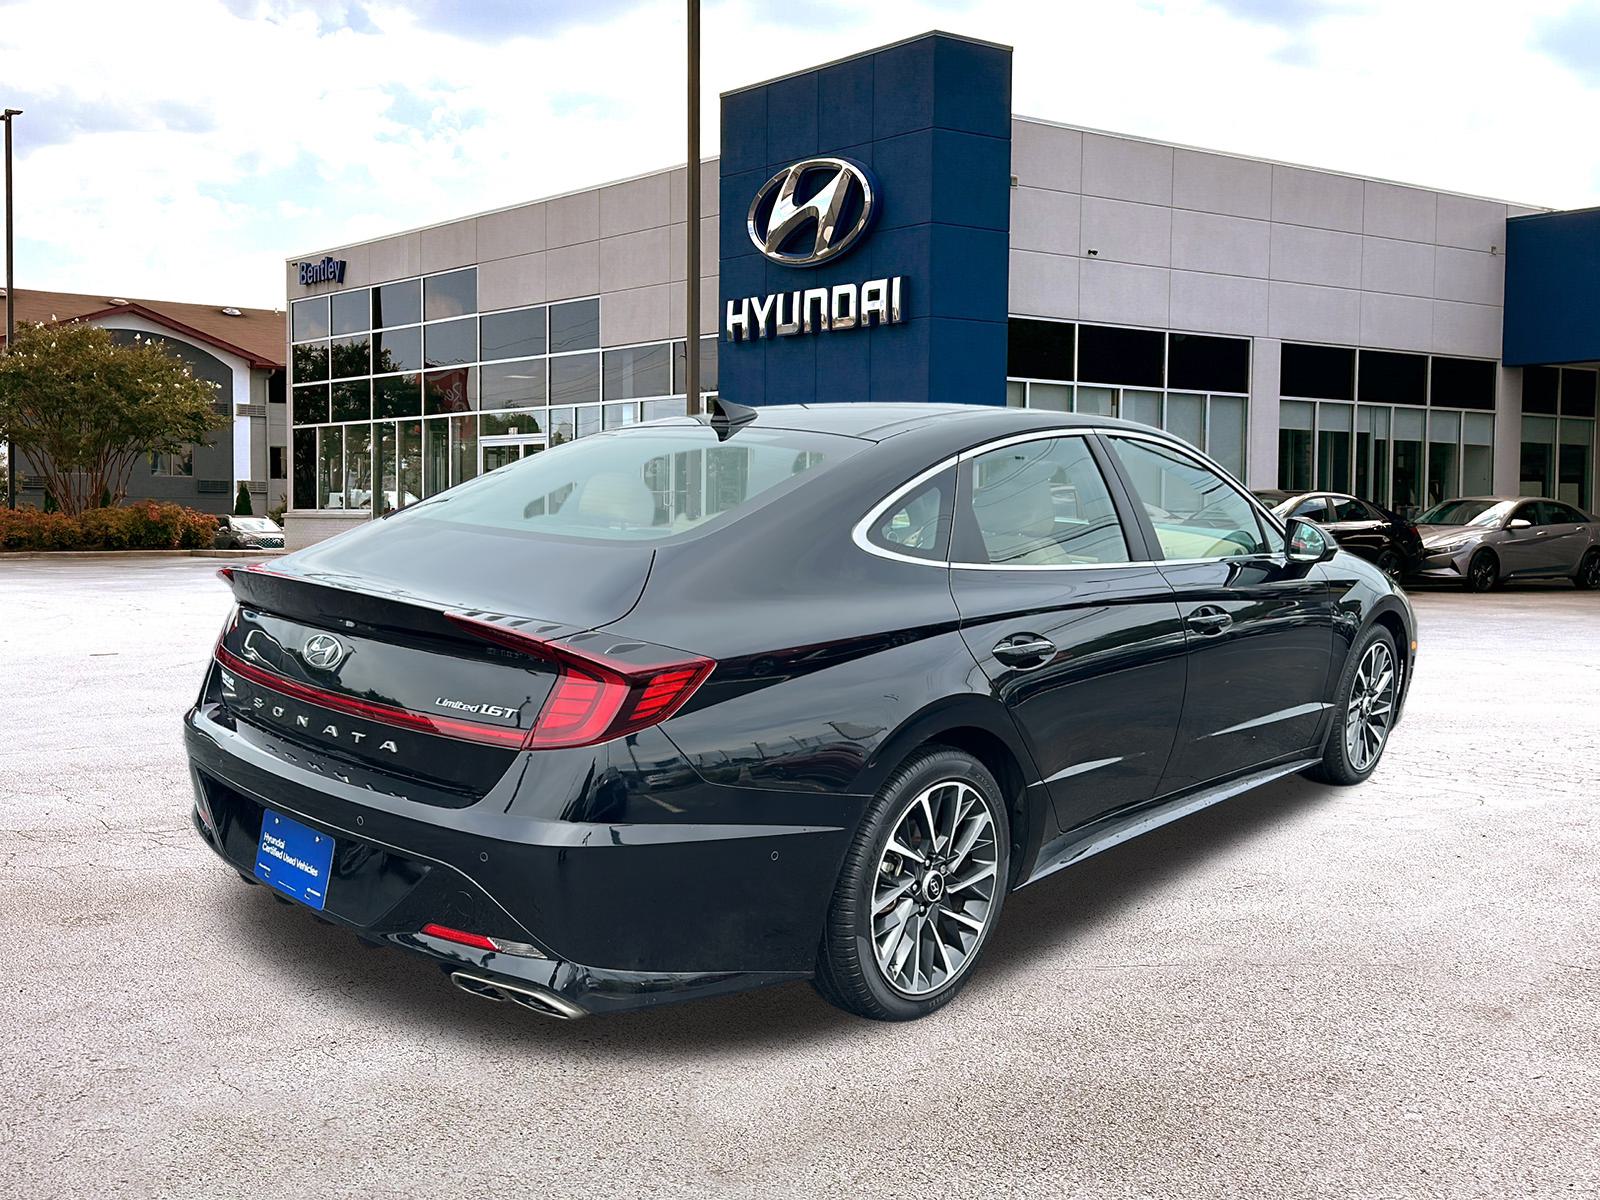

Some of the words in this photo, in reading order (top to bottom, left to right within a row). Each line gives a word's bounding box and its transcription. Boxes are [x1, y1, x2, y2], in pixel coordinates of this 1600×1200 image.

[298, 257, 343, 285] Bentley
[726, 276, 904, 342] HYUNDAI
[435, 697, 480, 713] Limited
[253, 697, 398, 753] SONATA
[263, 831, 286, 850] Hyundai
[261, 841, 284, 860] Certified
[282, 851, 297, 867] Used
[296, 858, 319, 877] Vehicles
